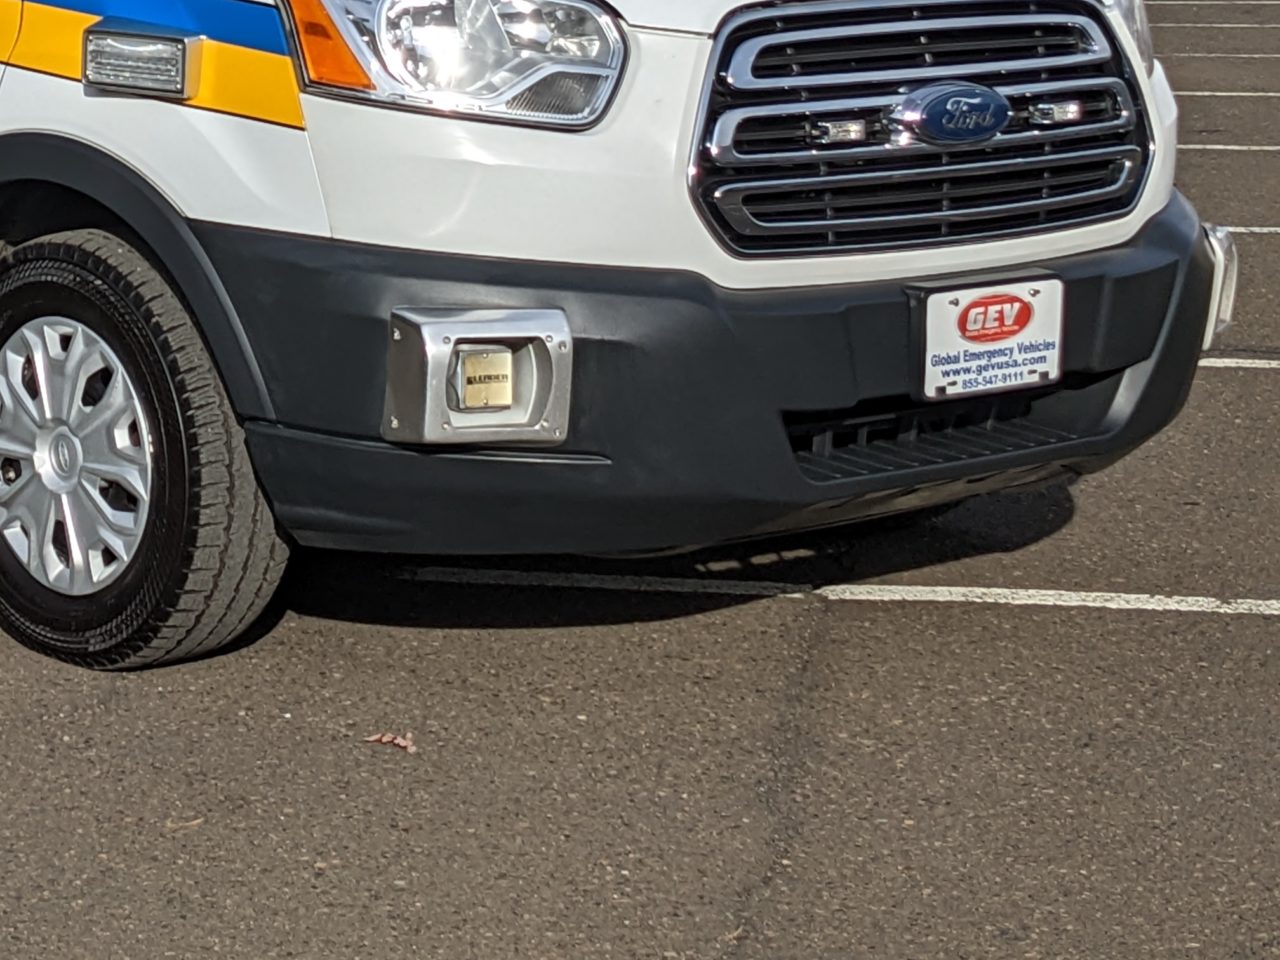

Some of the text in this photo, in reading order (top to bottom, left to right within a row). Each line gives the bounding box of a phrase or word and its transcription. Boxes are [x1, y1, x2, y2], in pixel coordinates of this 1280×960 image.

[942, 97, 995, 129] Ford
[965, 302, 1021, 331] GEV
[930, 339, 1056, 368] Global Emergency Vehicles
[940, 354, 1047, 378] www.gevusa.com
[961, 370, 1024, 390] 855-547-9111
